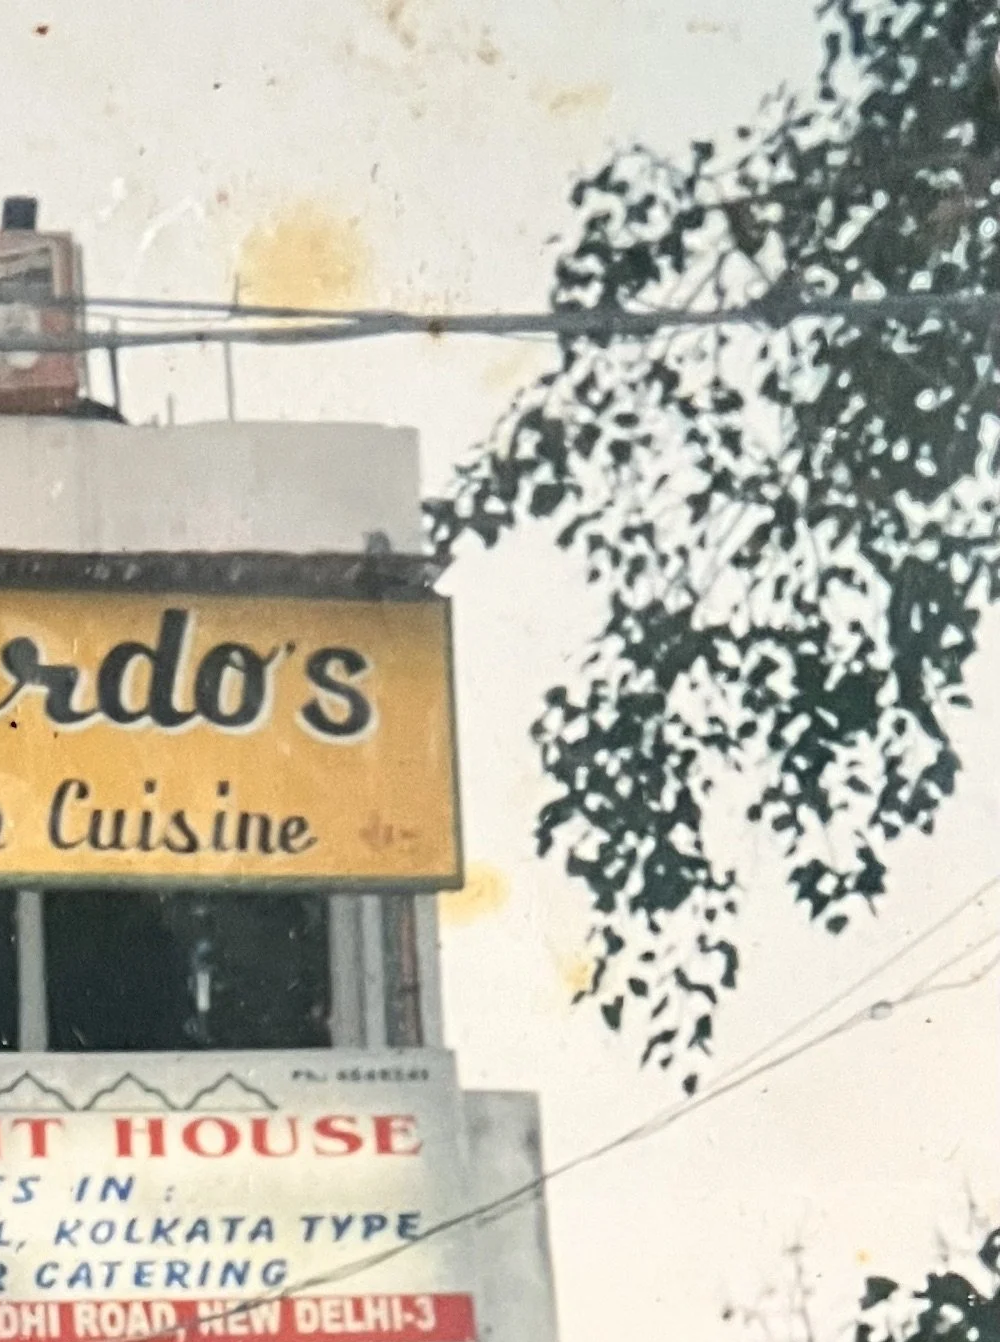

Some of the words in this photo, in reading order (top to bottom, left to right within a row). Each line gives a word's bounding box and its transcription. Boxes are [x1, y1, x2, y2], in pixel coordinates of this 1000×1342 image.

[48, 778, 317, 854] Cuisine
[112, 1114, 424, 1159] HOUSE
[75, 1174, 134, 1203] IN
[54, 1214, 276, 1247] KOLKATA
[299, 1211, 423, 1244] TYPE
[34, 1258, 289, 1290] CATERING
[198, 1299, 282, 1336] NEW
[297, 1292, 437, 1333] DELHI-3
